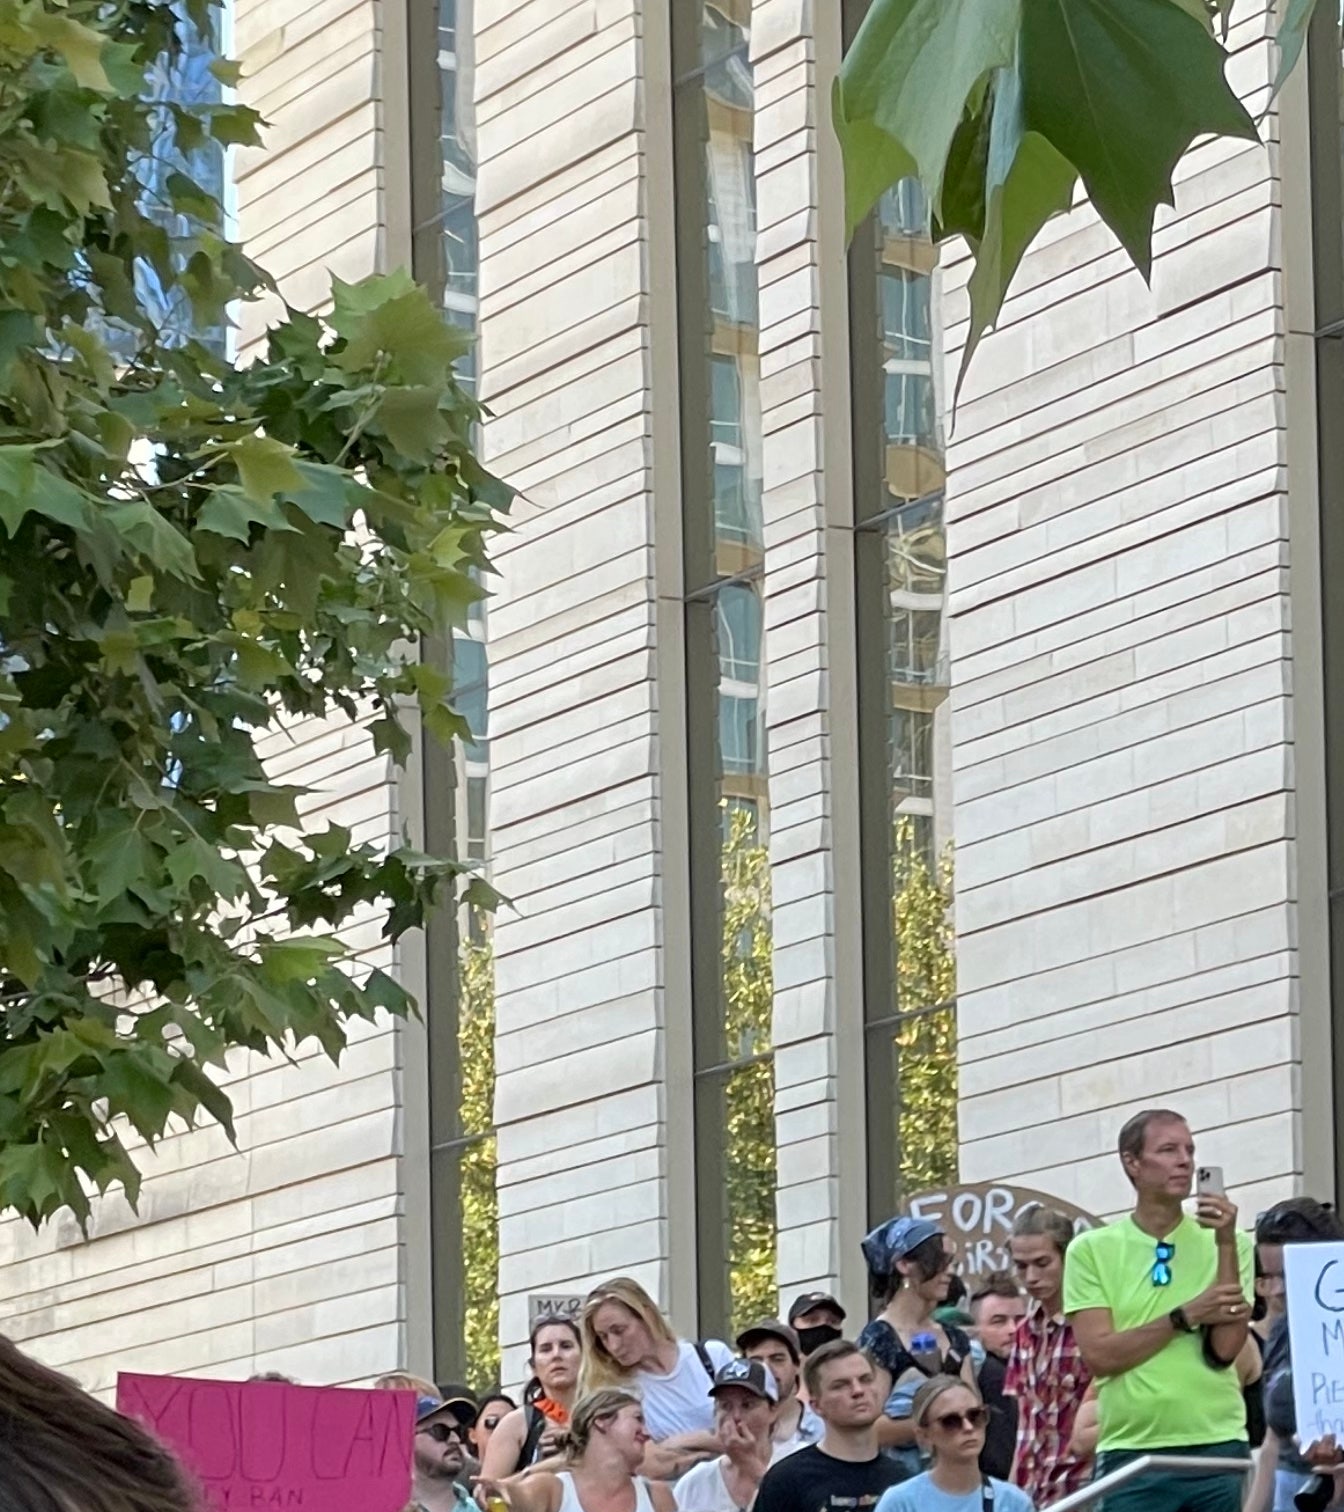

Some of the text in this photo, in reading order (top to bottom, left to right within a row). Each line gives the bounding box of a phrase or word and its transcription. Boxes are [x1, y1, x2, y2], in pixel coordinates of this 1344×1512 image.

[132, 1382, 412, 1483] YOU CAN
[251, 1487, 304, 1505] BAN
